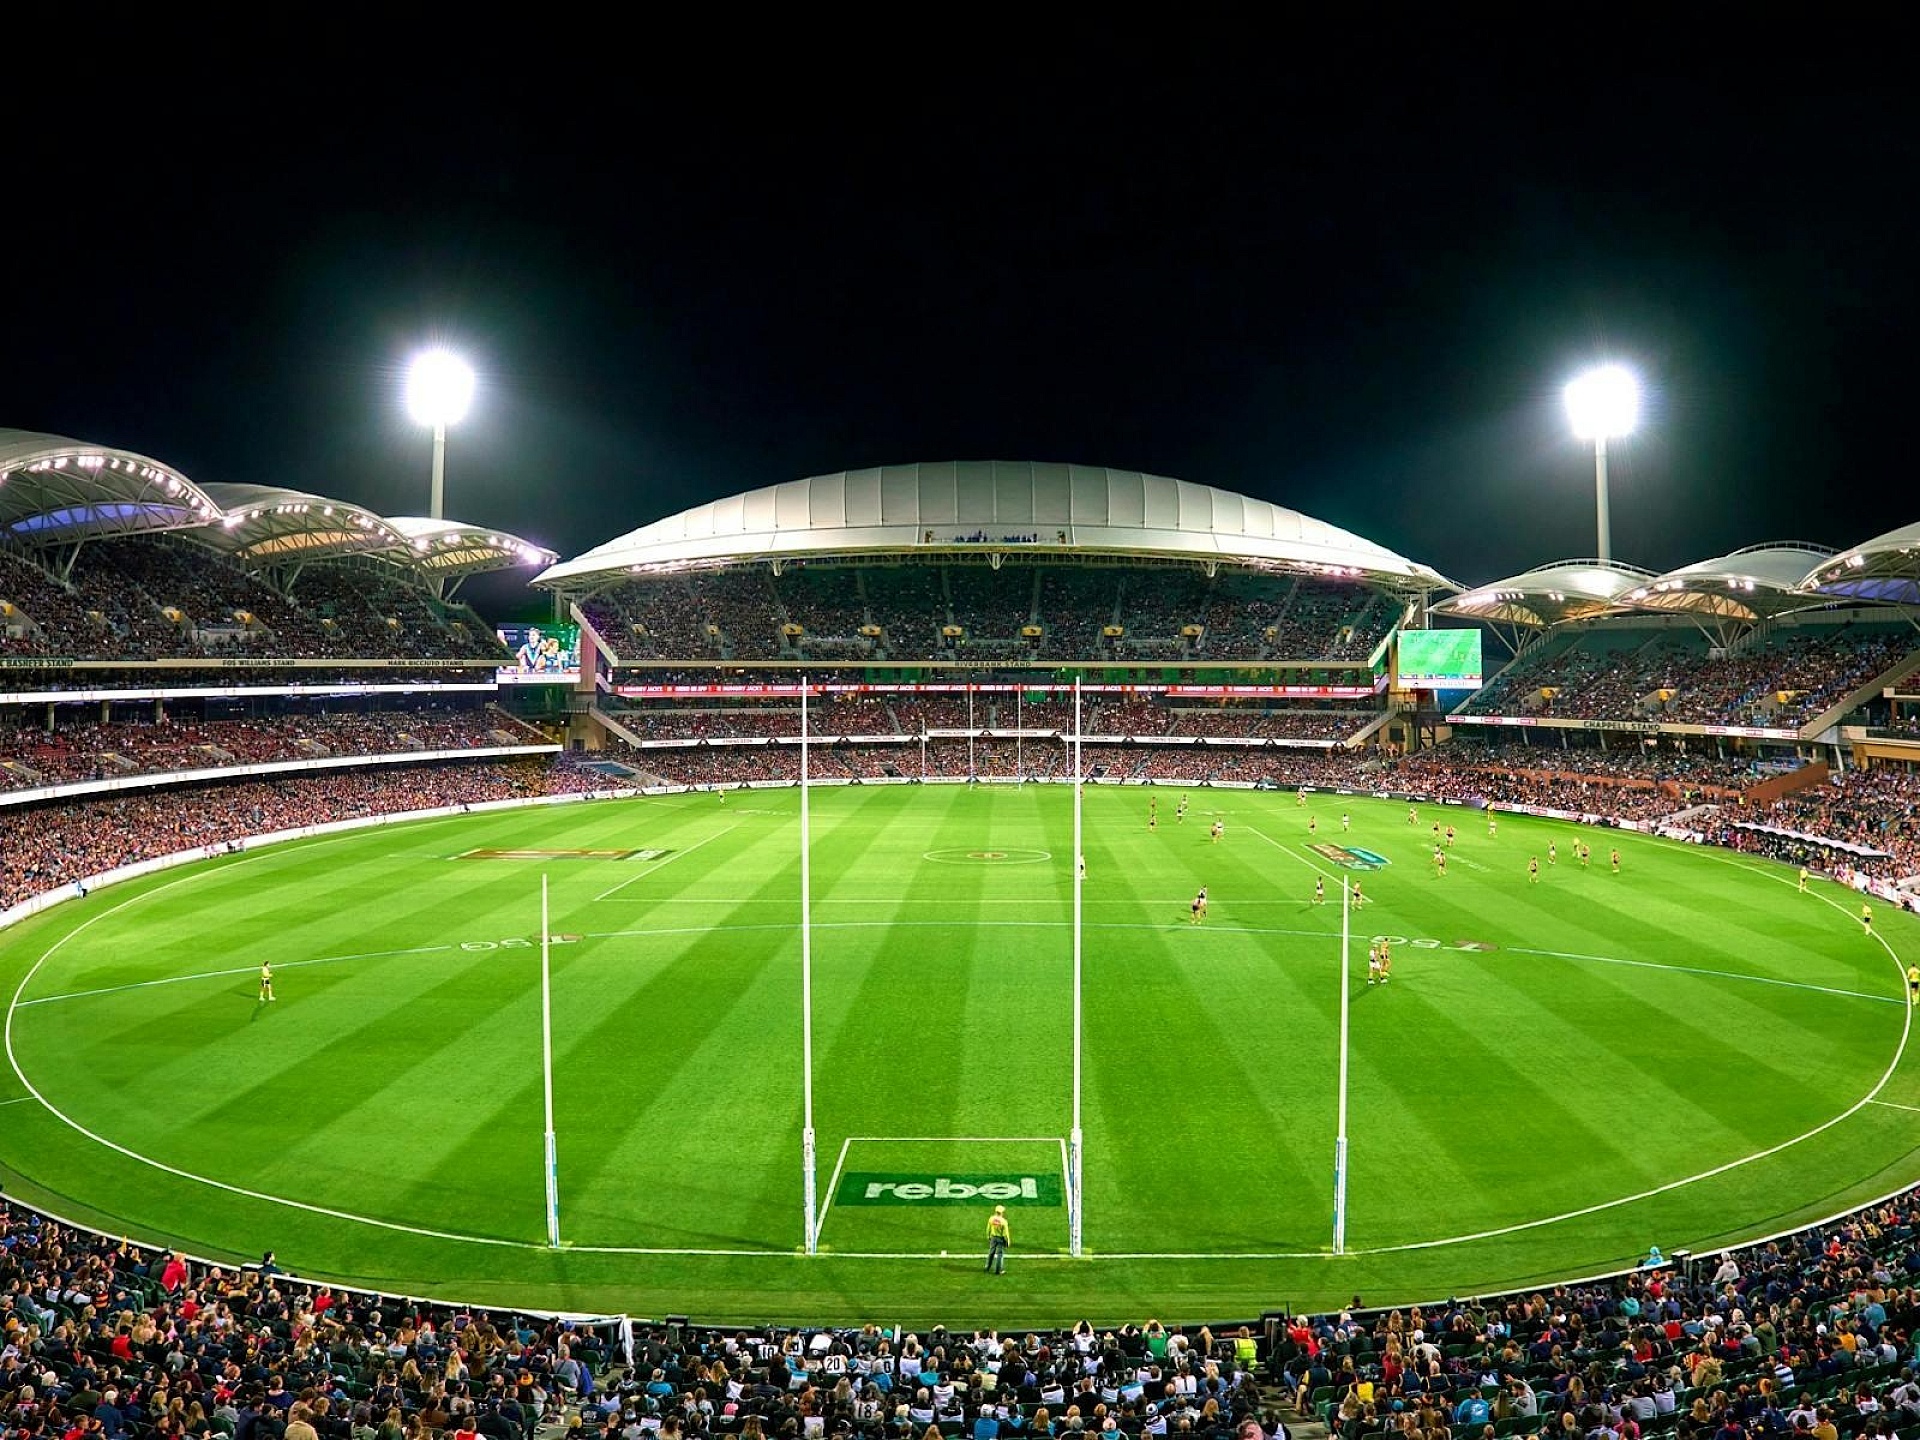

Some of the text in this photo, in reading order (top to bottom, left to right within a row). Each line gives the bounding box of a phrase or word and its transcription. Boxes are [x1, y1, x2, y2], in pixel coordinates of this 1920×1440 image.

[6, 659, 74, 667] BASHEER STAND
[1583, 721, 1661, 732] CHAPPELL STAND
[864, 1177, 1038, 1200] rebel
[826, 1356, 840, 1371] 20
[857, 1403, 872, 1418] 18
